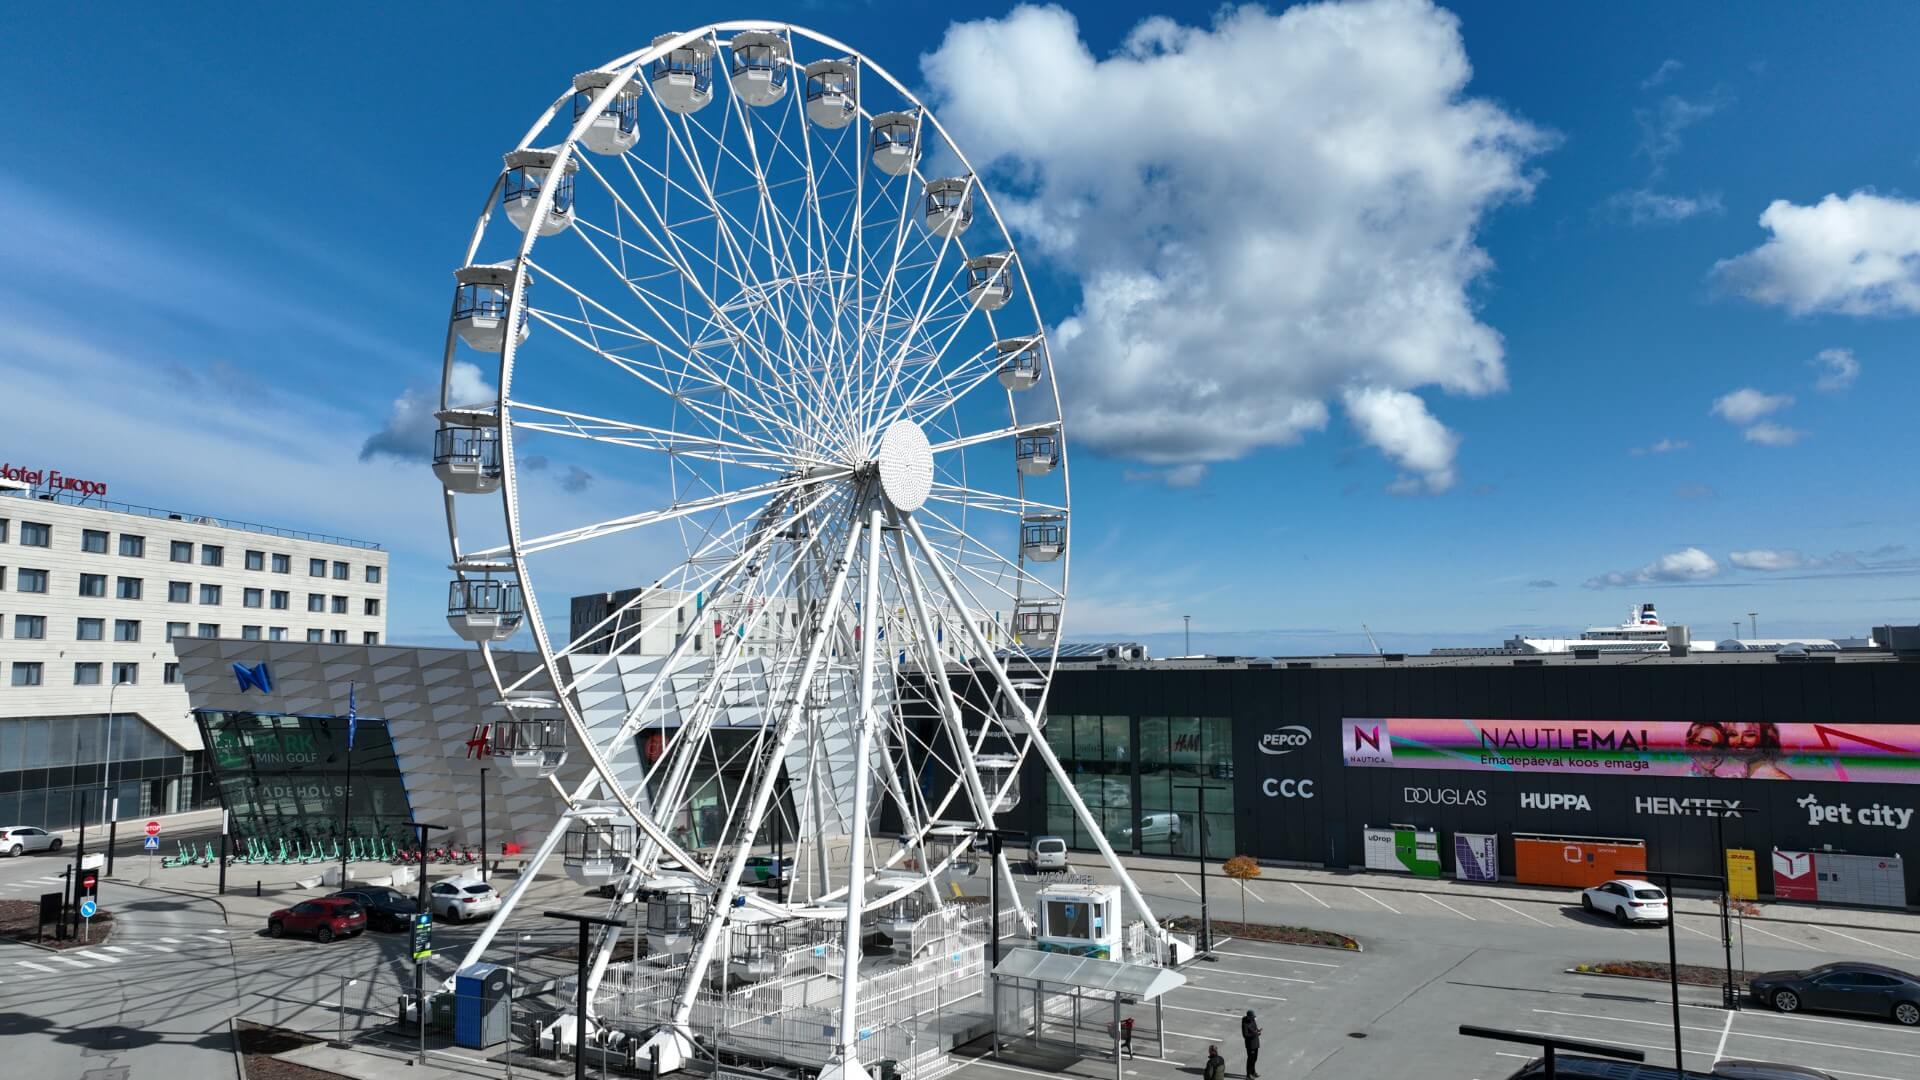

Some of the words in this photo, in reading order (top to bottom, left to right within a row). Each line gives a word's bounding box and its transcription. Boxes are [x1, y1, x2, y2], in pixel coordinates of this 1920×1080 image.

[50, 470, 107, 495] Europa
[1263, 734, 1308, 746] PEPCO
[1481, 728, 1648, 751] NAUTLEMA!
[256, 753, 284, 764] MINI
[286, 752, 318, 764] GOLF
[1350, 756, 1386, 764] NAUTICA
[1481, 755, 1564, 768] Emadepäeval
[1569, 756, 1600, 768] koos
[1605, 759, 1649, 772] emaga
[1262, 778, 1315, 799] CCC
[1404, 787, 1487, 807] DOUGLAS
[1520, 792, 1592, 812] HUPPA
[1635, 796, 1743, 818] HEMTEX
[1808, 802, 1853, 826] pet
[1858, 803, 1914, 830] city
[1368, 835, 1392, 844] uDrop
[1485, 839, 1495, 879] Venipak
